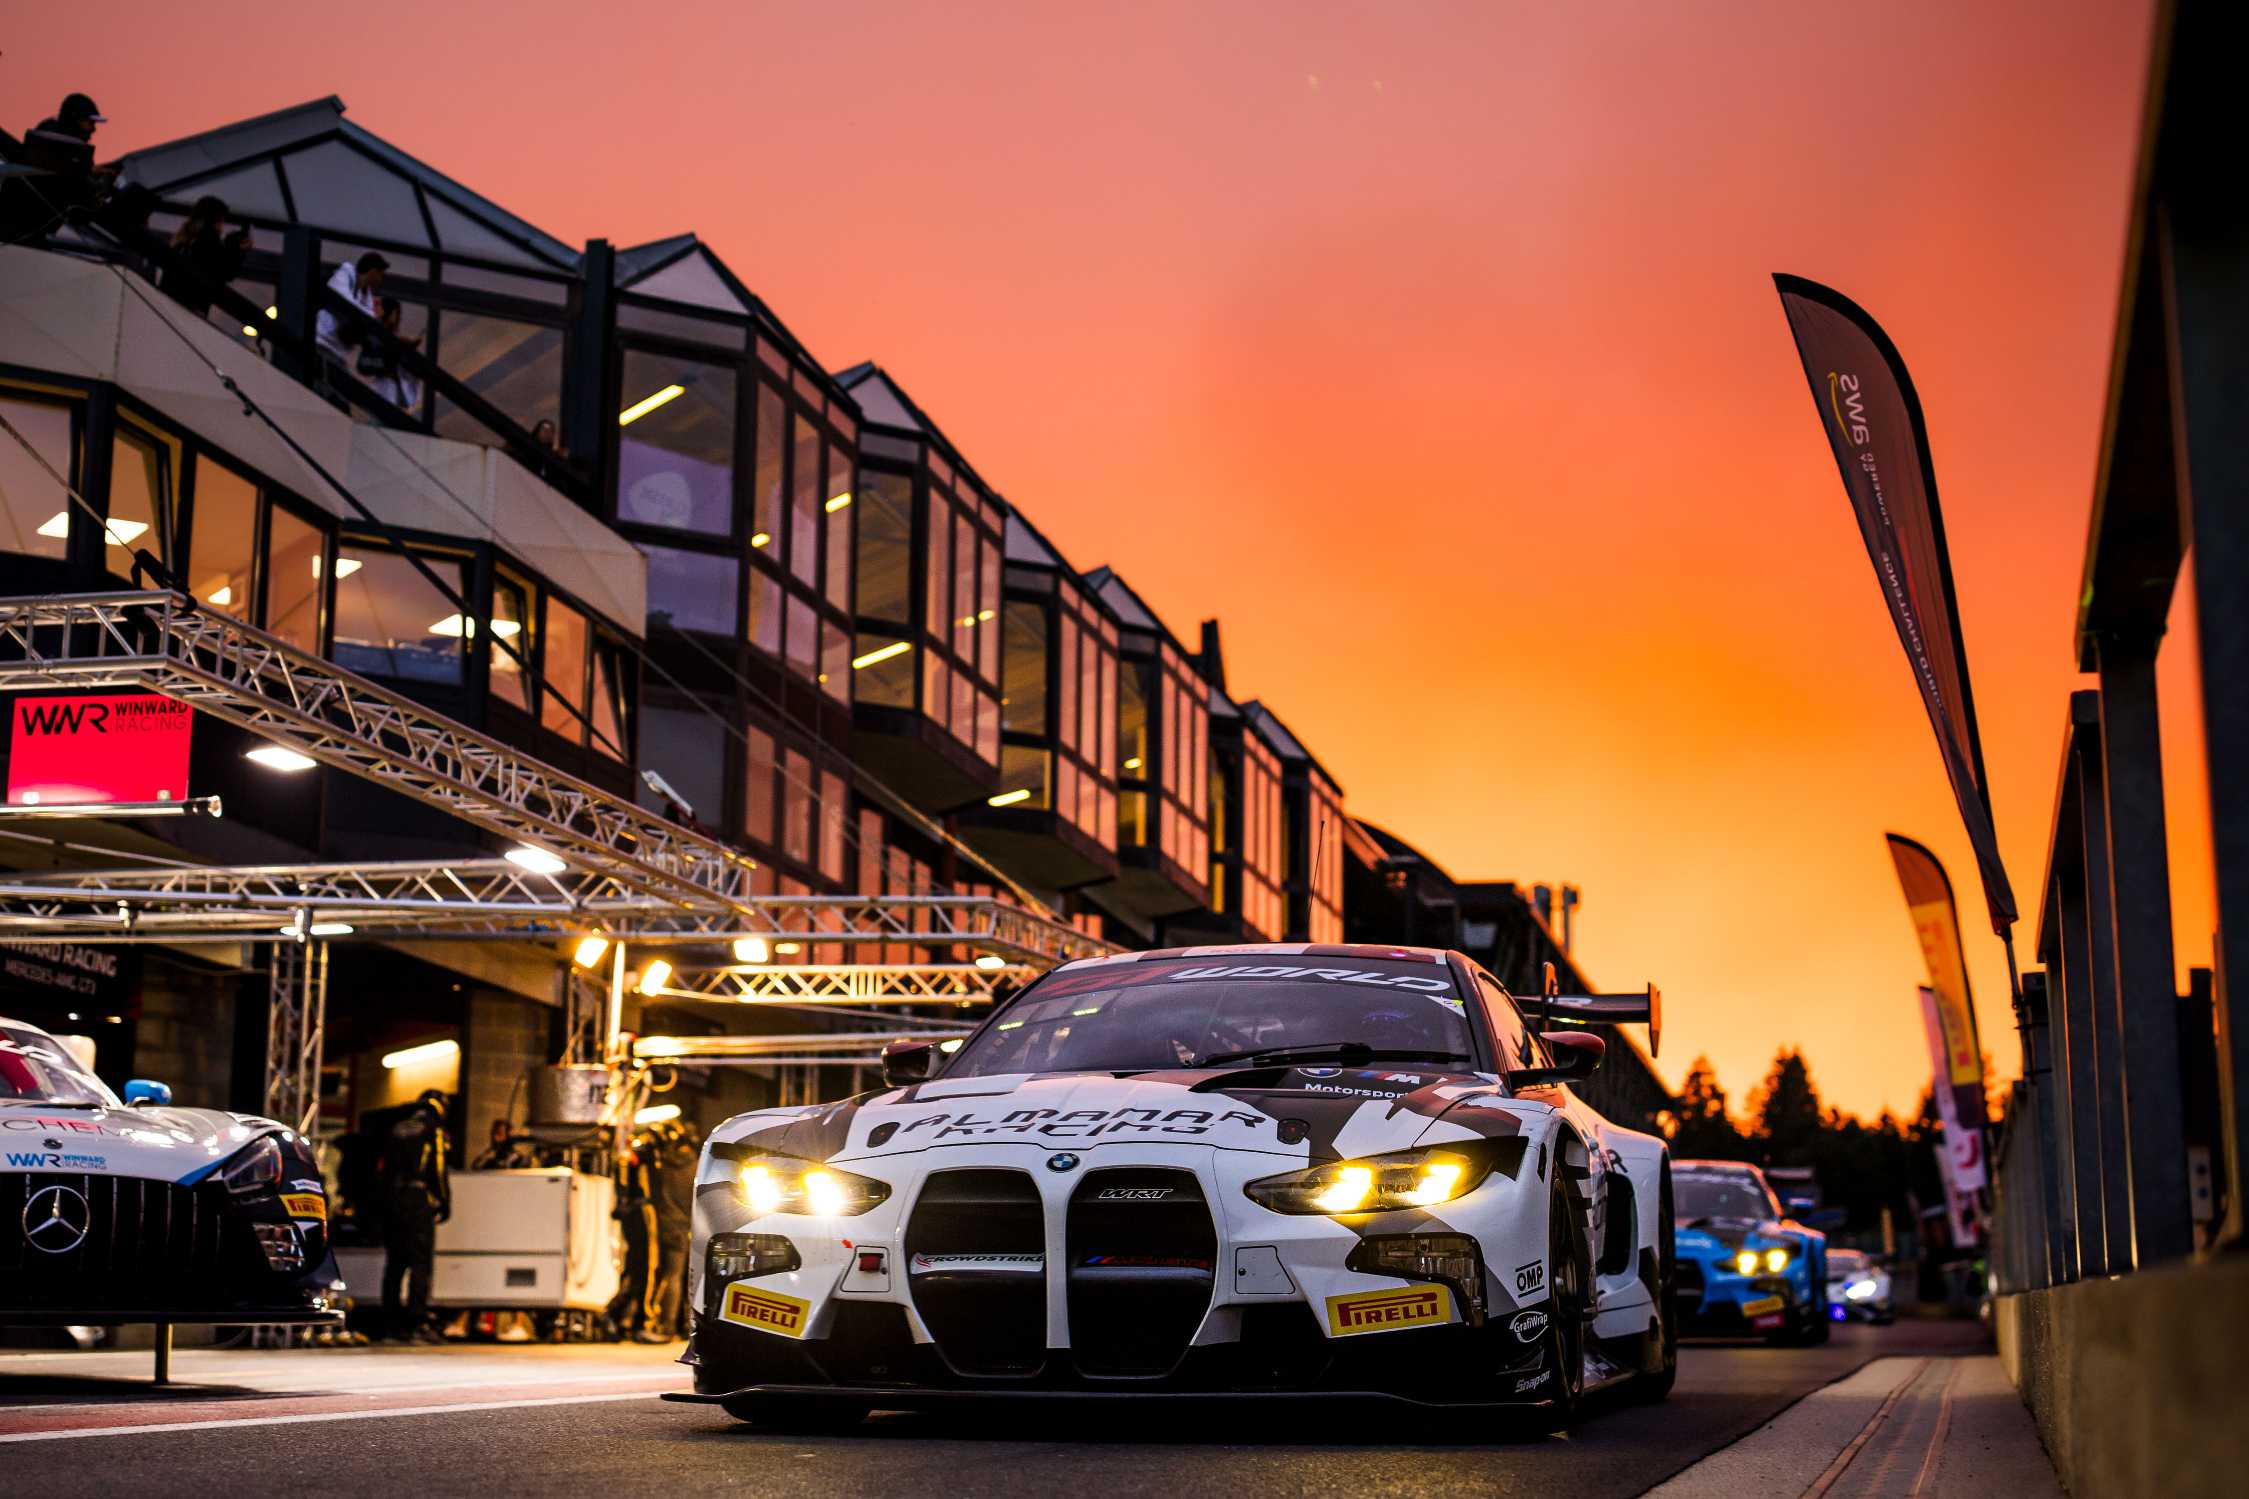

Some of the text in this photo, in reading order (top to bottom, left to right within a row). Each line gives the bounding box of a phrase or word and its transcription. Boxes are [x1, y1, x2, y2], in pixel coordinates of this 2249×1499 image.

[115, 700, 187, 716] WINWARD
[115, 715, 188, 732] RACING
[1167, 966, 1451, 991] WORLD
[1304, 1082, 1409, 1099] Motorspor
[1098, 1188, 1174, 1200] WRT
[924, 1254, 1045, 1264] CROWDSTRIKE
[1516, 1265, 1544, 1292] OMP
[731, 1290, 801, 1329] PIRELLI
[1337, 1291, 1439, 1328] PIRELLI
[1513, 1313, 1549, 1334] GrafiWrap
[1515, 1371, 1551, 1392] Snap-on
